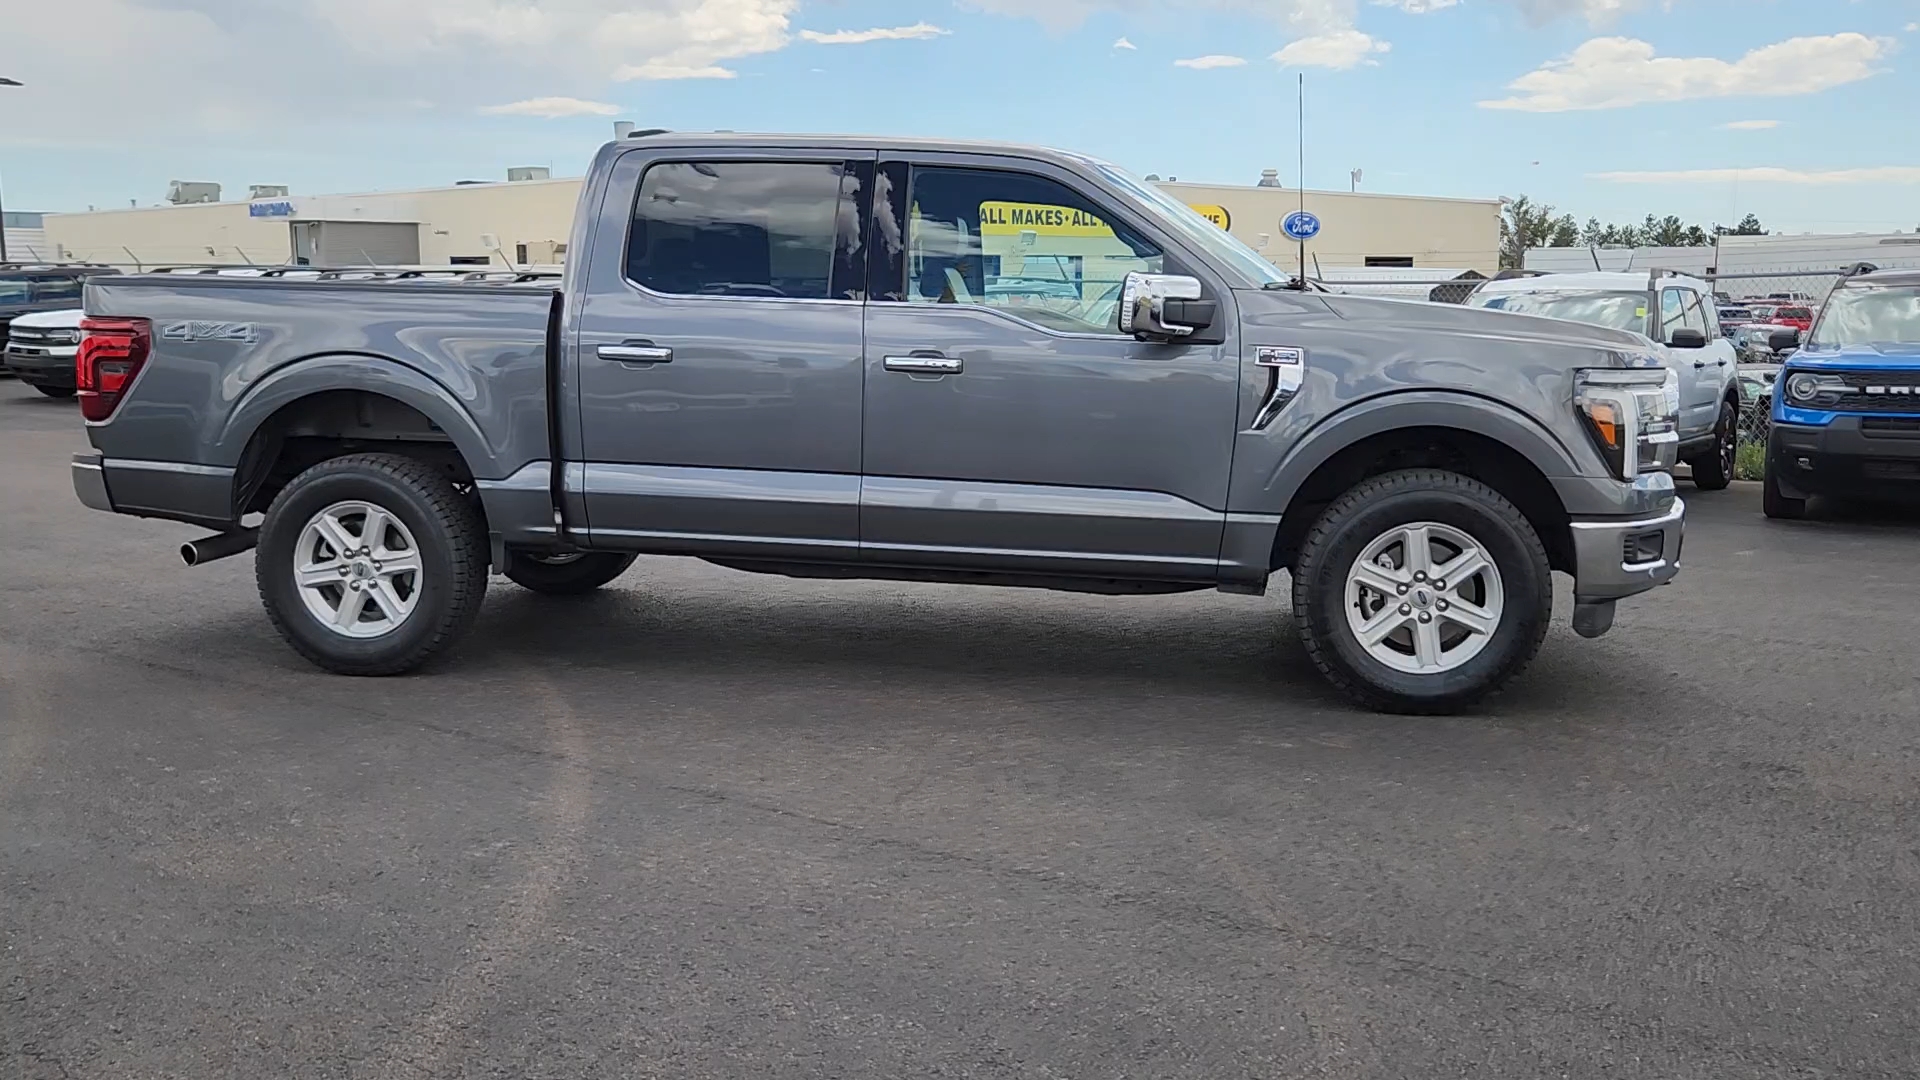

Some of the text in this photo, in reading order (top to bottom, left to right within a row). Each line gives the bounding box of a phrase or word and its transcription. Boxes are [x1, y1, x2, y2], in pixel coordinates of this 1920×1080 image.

[980, 208, 1097, 226] ALL MAKES ALL
